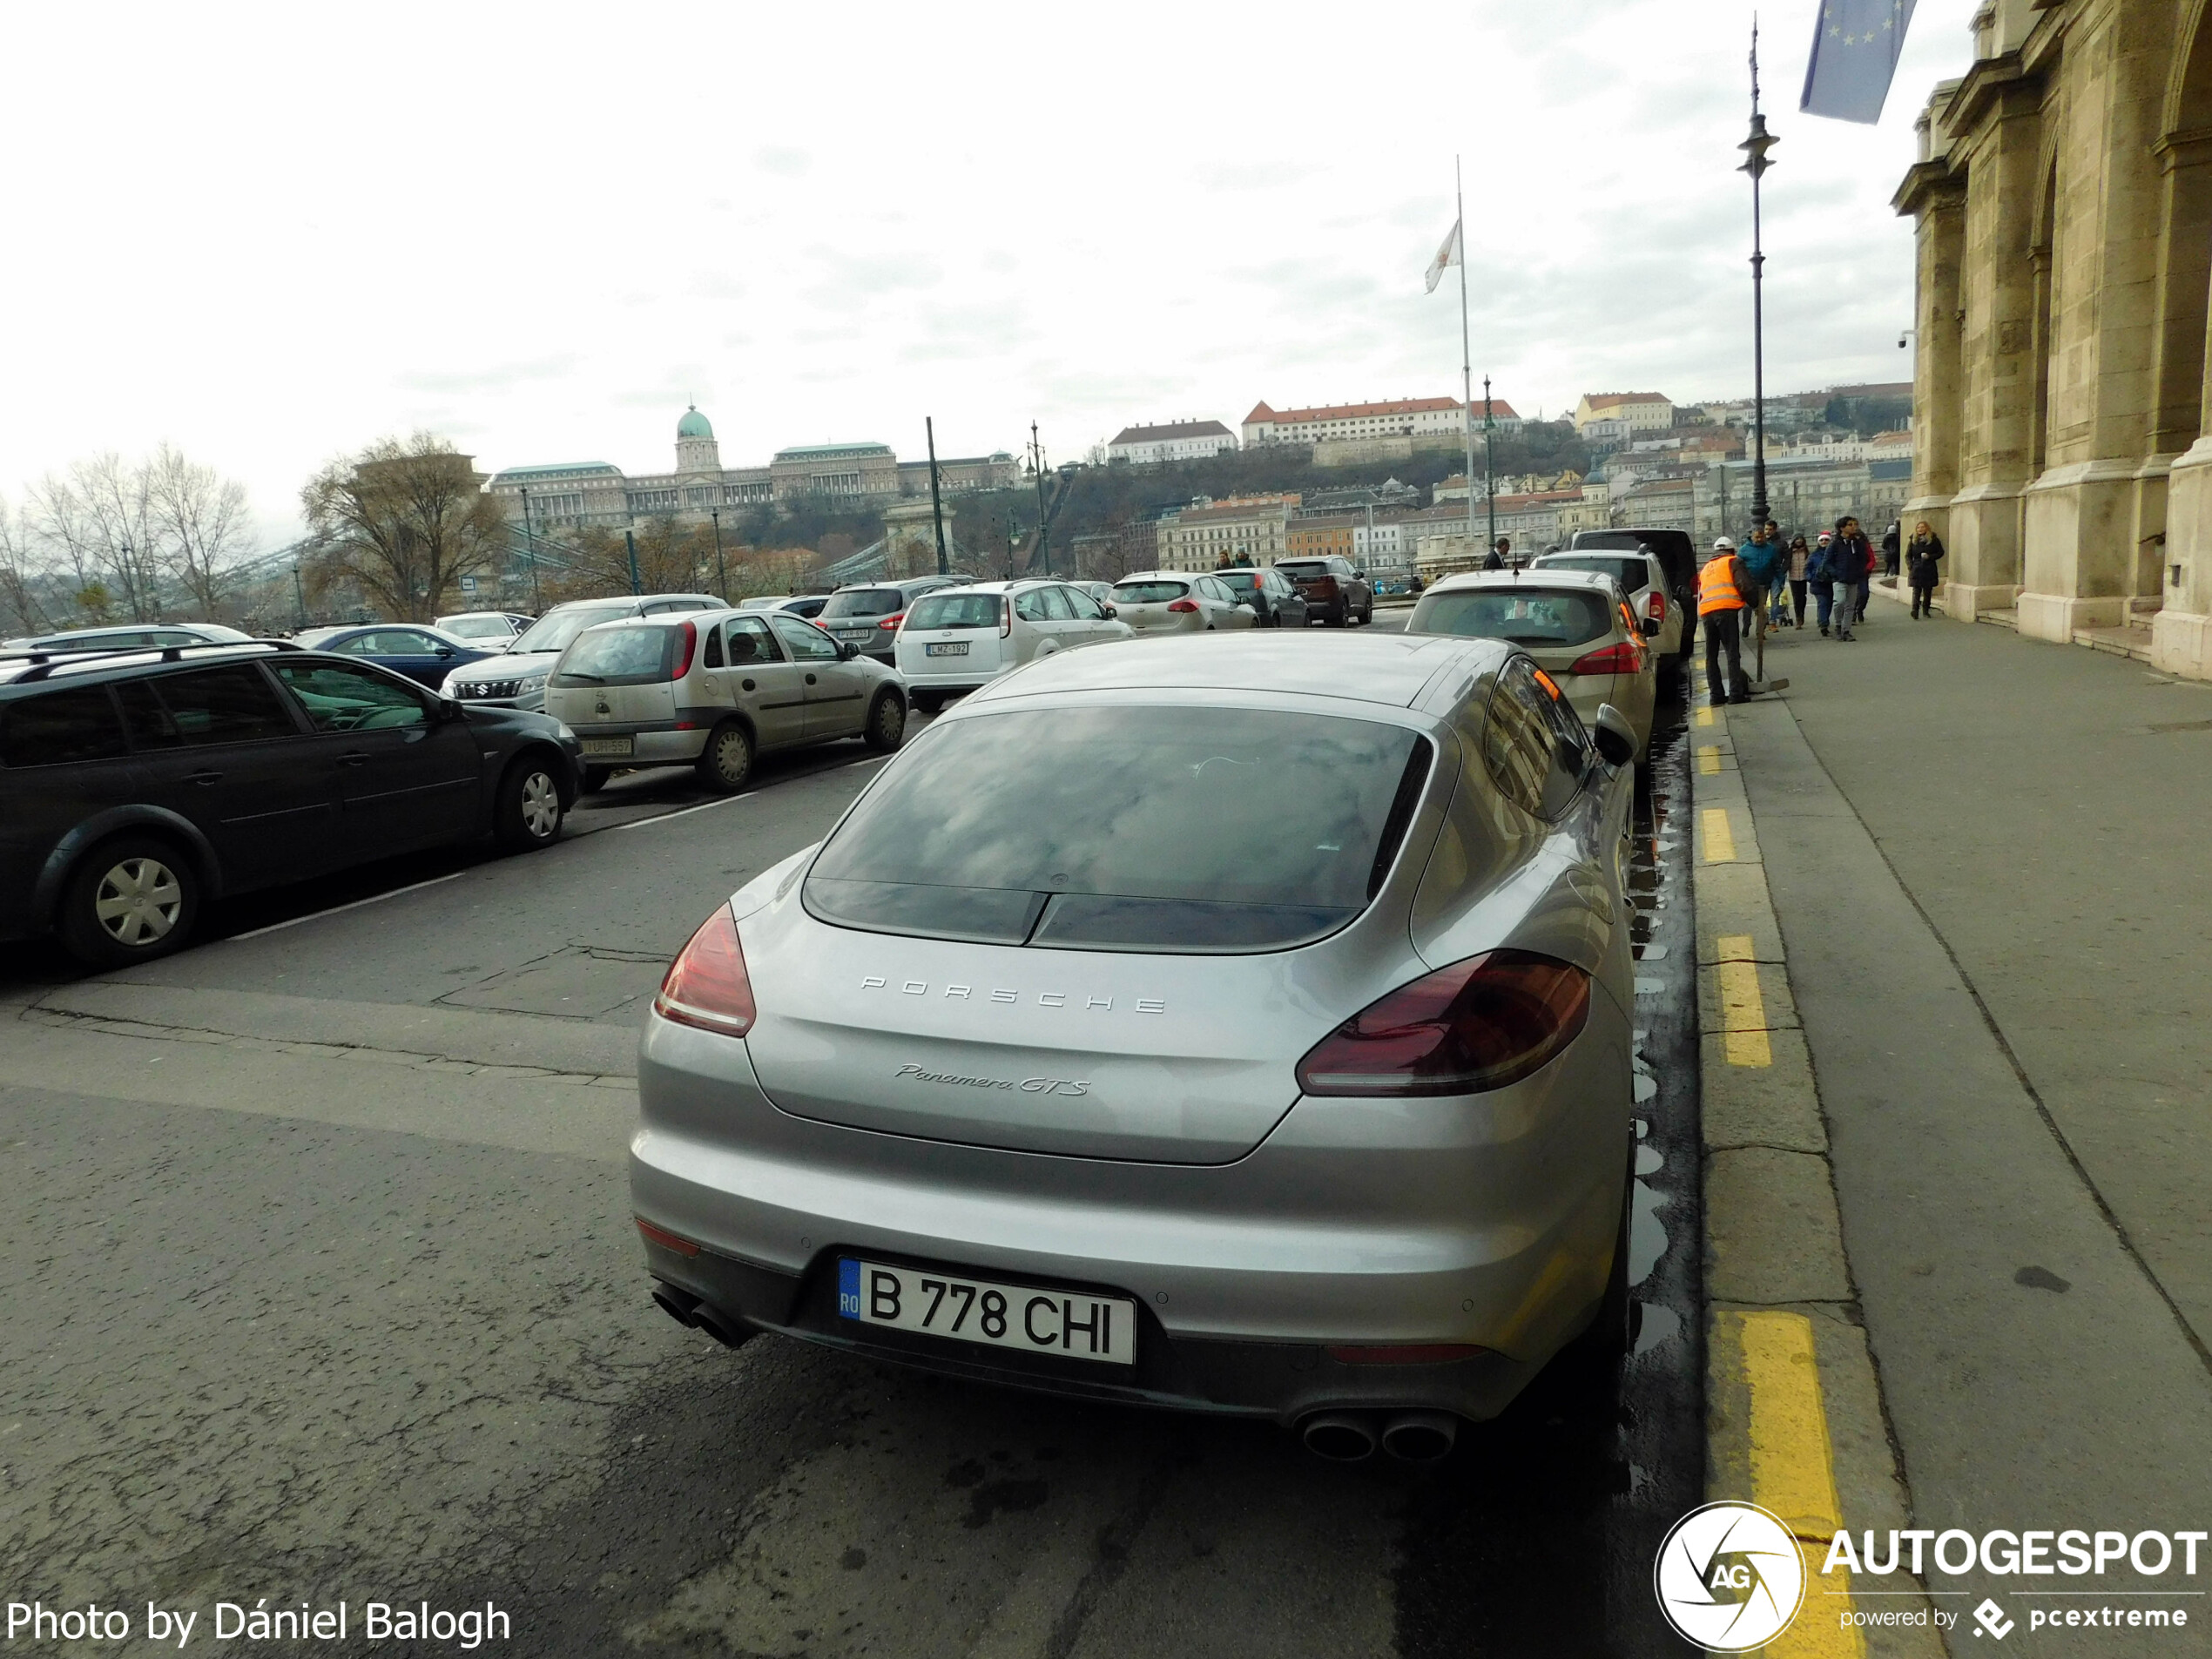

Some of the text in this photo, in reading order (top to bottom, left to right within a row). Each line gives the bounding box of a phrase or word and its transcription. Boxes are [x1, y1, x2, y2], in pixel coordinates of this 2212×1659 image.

[931, 644, 966, 654] LMZ-192
[860, 976, 1165, 1014] PORSCHE
[894, 1063, 1091, 1096] Panamera GTS
[840, 1292, 859, 1313] RO
[871, 1269, 1110, 1354] B 778 CHI
